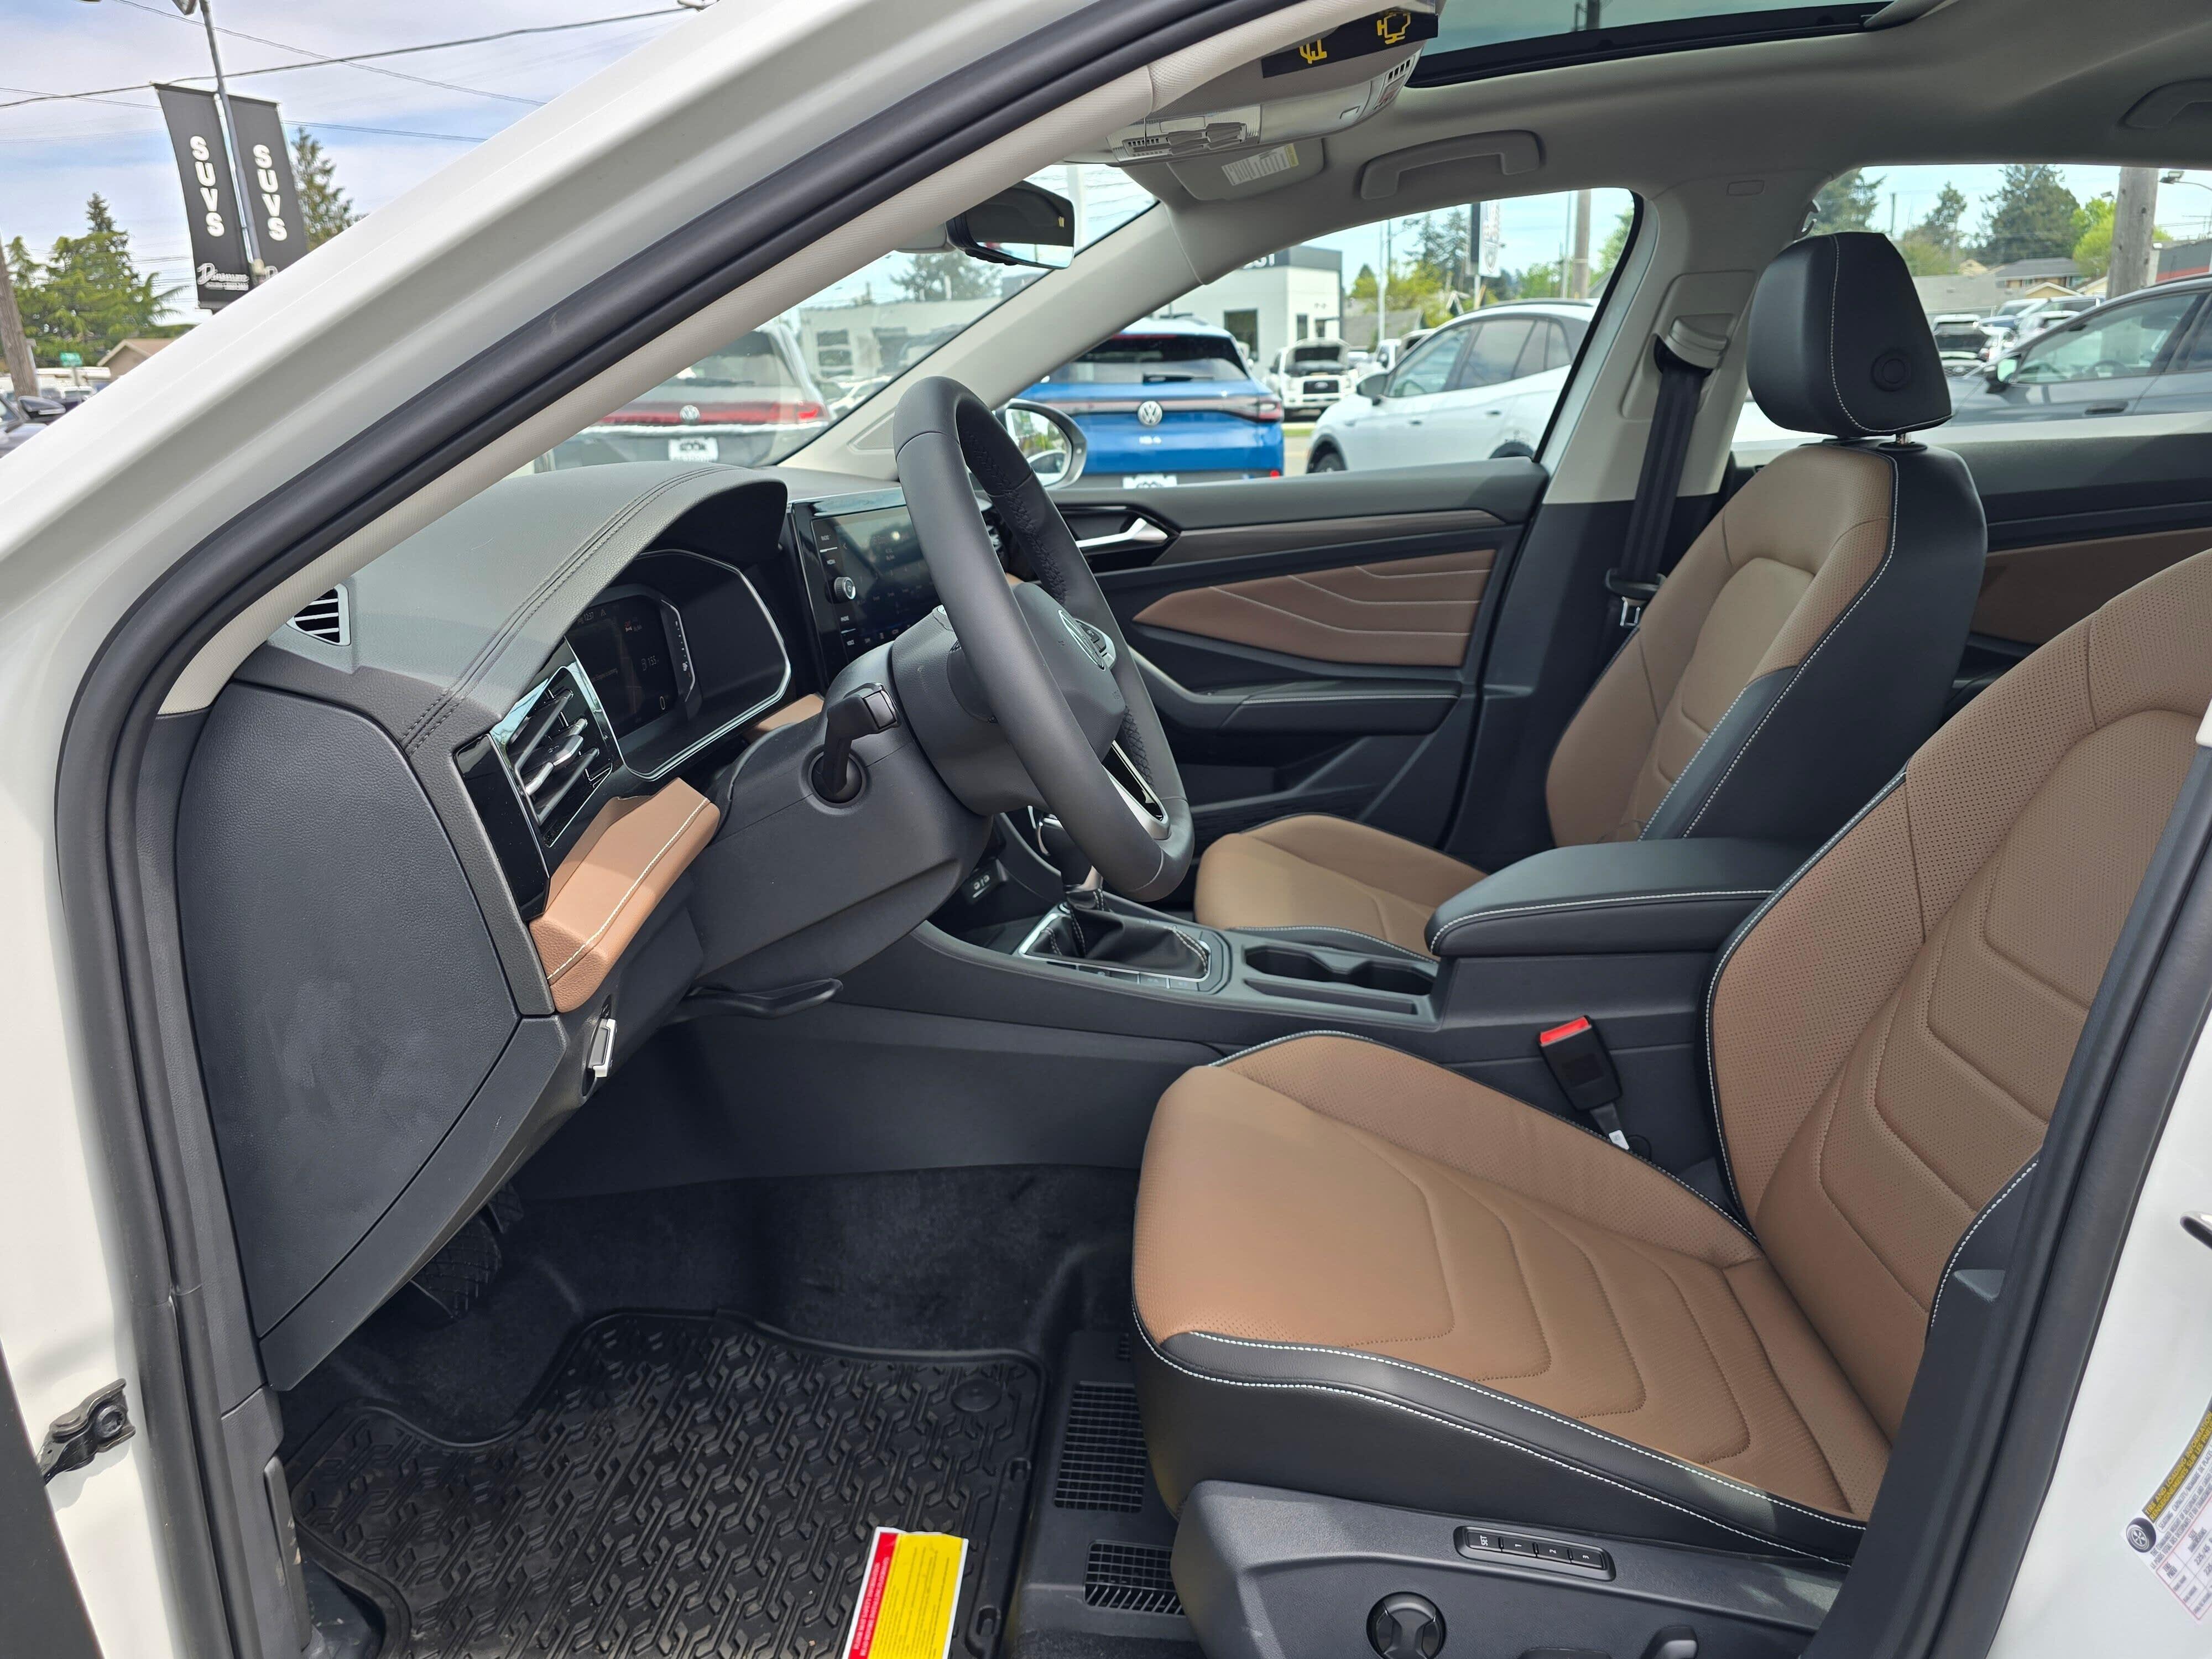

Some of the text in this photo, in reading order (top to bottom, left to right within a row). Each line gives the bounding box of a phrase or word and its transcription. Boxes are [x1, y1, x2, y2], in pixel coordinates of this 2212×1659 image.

[190, 135, 225, 237] SUVS
[253, 144, 288, 241] SUVS
[2145, 1410, 2212, 1515] TIRE AND LOADING INFORMATION
[2186, 1453, 2197, 1468] SUR
[2195, 1442, 2204, 1455] LES
[1480, 1535, 1488, 1546] SET
